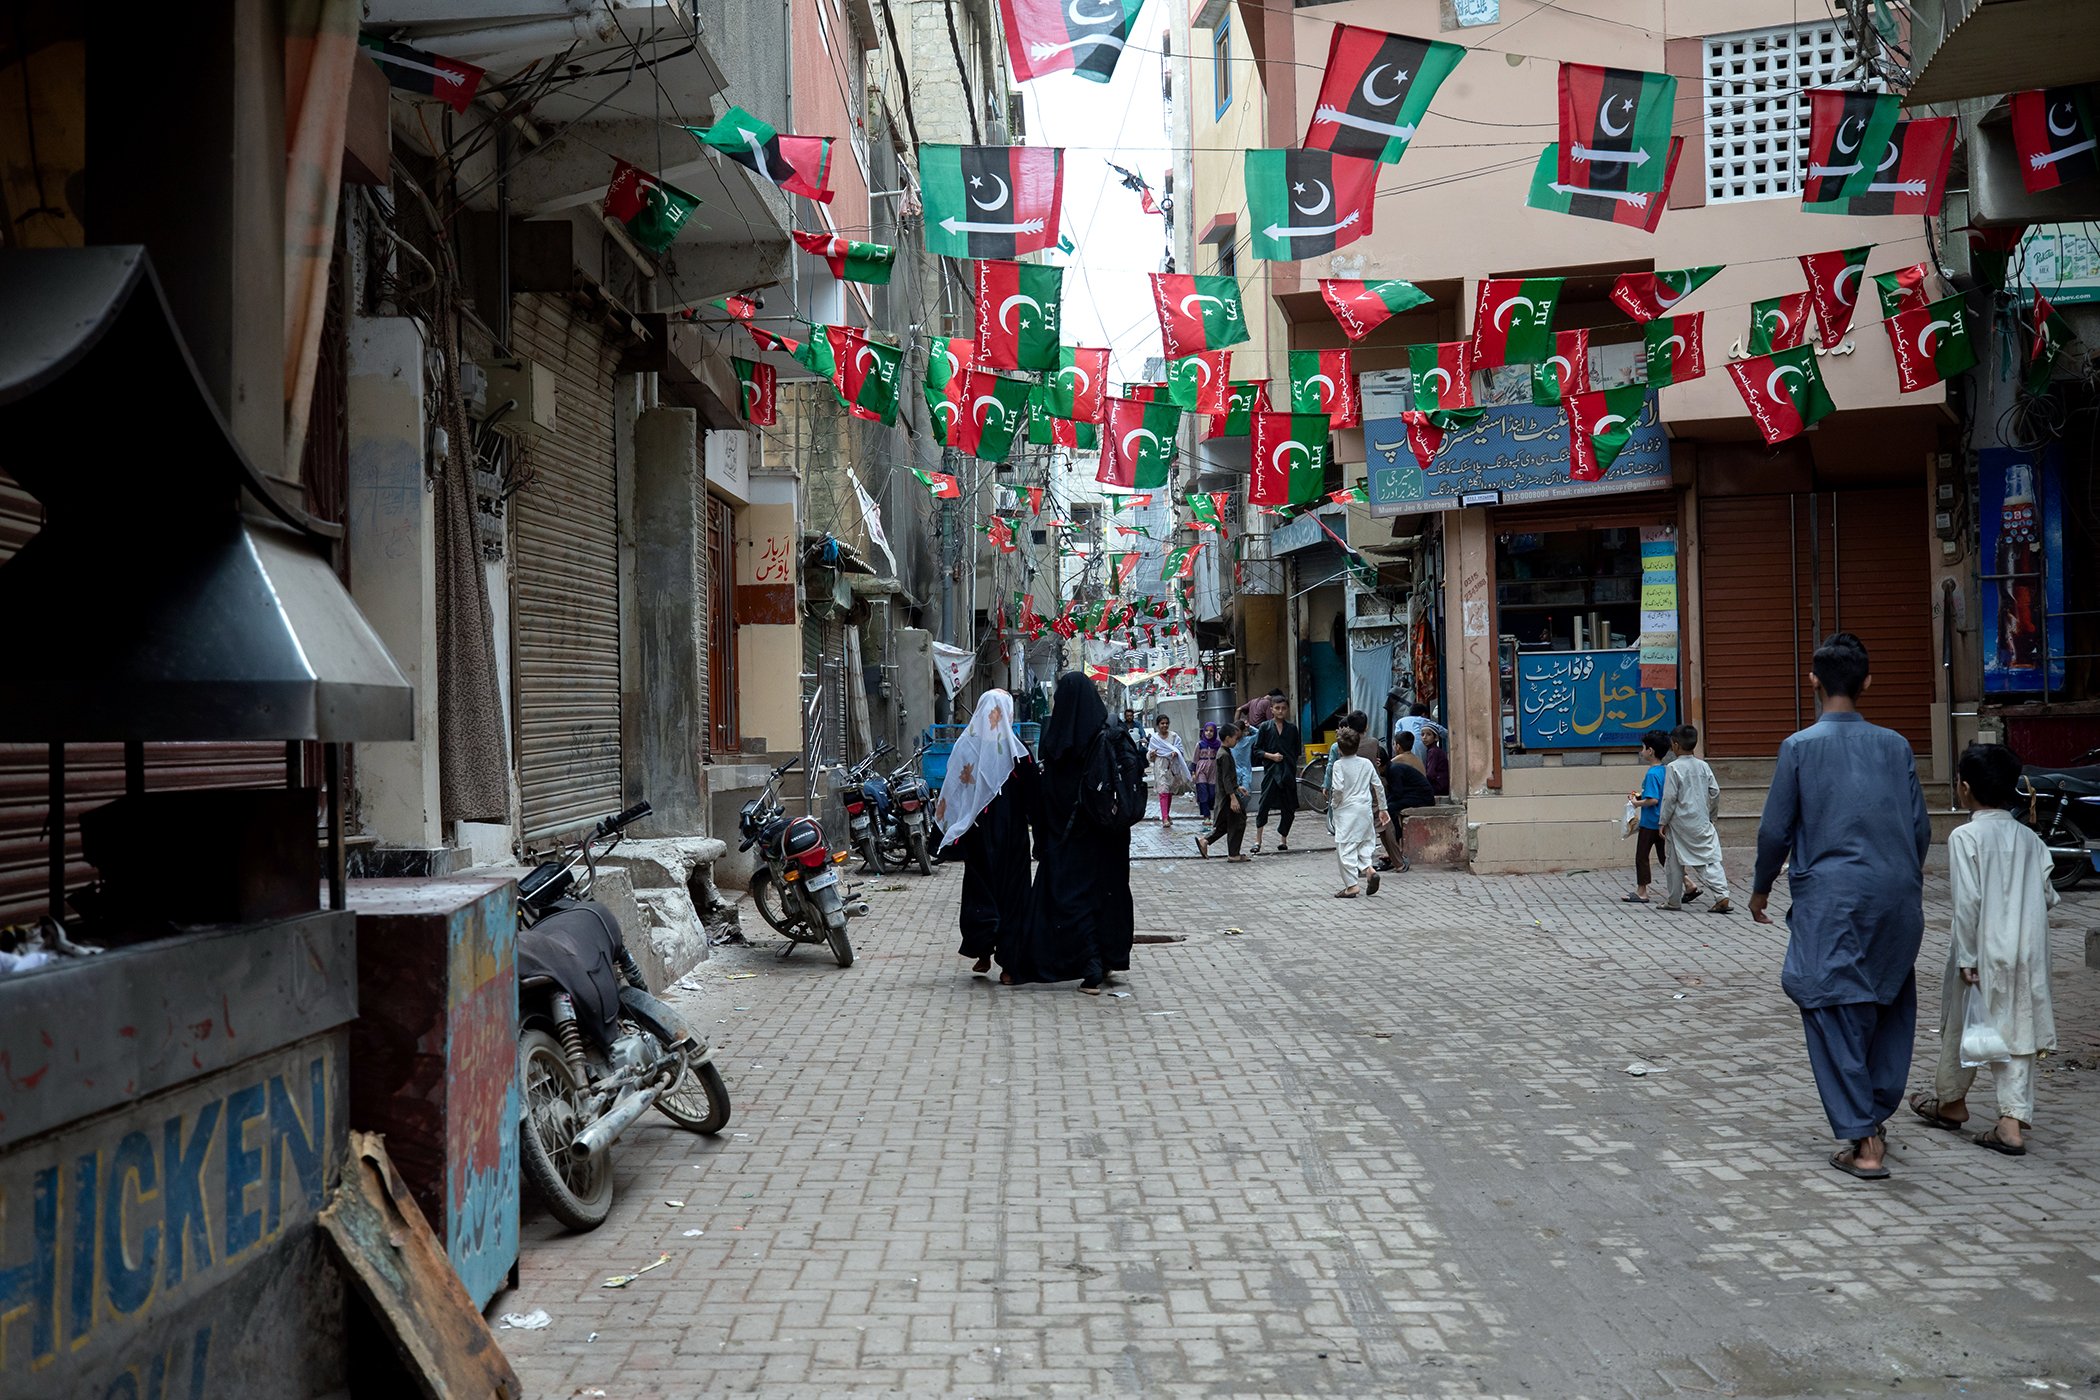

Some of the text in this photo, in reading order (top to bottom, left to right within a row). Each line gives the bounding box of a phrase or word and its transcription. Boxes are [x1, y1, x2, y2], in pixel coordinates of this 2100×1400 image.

[980, 260, 991, 292] انصاف
[1225, 298, 1237, 321] PTI
[1813, 281, 1830, 313] تحریک
[1044, 302, 1057, 331] PTI
[1533, 299, 1552, 326] PTI
[1950, 310, 1964, 337] PTI
[1163, 320, 1180, 355] پاکستان
[1819, 309, 1839, 344] پاکستان
[977, 324, 992, 361] پاکستان
[1896, 334, 1912, 365] تحریک
[880, 361, 895, 384] PTI
[1800, 358, 1815, 383] PTI
[1899, 361, 1919, 390] پاکستان
[1744, 385, 1766, 415] تحریک
[1003, 409, 1018, 433] PTI
[1258, 412, 1267, 440] انصاف
[1757, 411, 1781, 441] پاکستان
[1159, 436, 1173, 460] PTI
[1310, 445, 1323, 469] PTI
[1646, 437, 1662, 452] فوٹو
[1574, 442, 1590, 475] پاکستان
[1254, 467, 1267, 499] پاکستان
[1552, 488, 1573, 498] Email:
[1378, 504, 1403, 514] Muneer
[1404, 503, 1416, 512] Jee
[1416, 502, 1423, 511] &
[1423, 501, 1452, 511] Brothers
[1525, 660, 1572, 686] اسٹیٹ
[1571, 655, 1595, 682] فوٹو
[1524, 685, 1577, 726] اسٹیشنری
[1537, 719, 1569, 741] شاپ
[790, 830, 815, 843] HONDA
